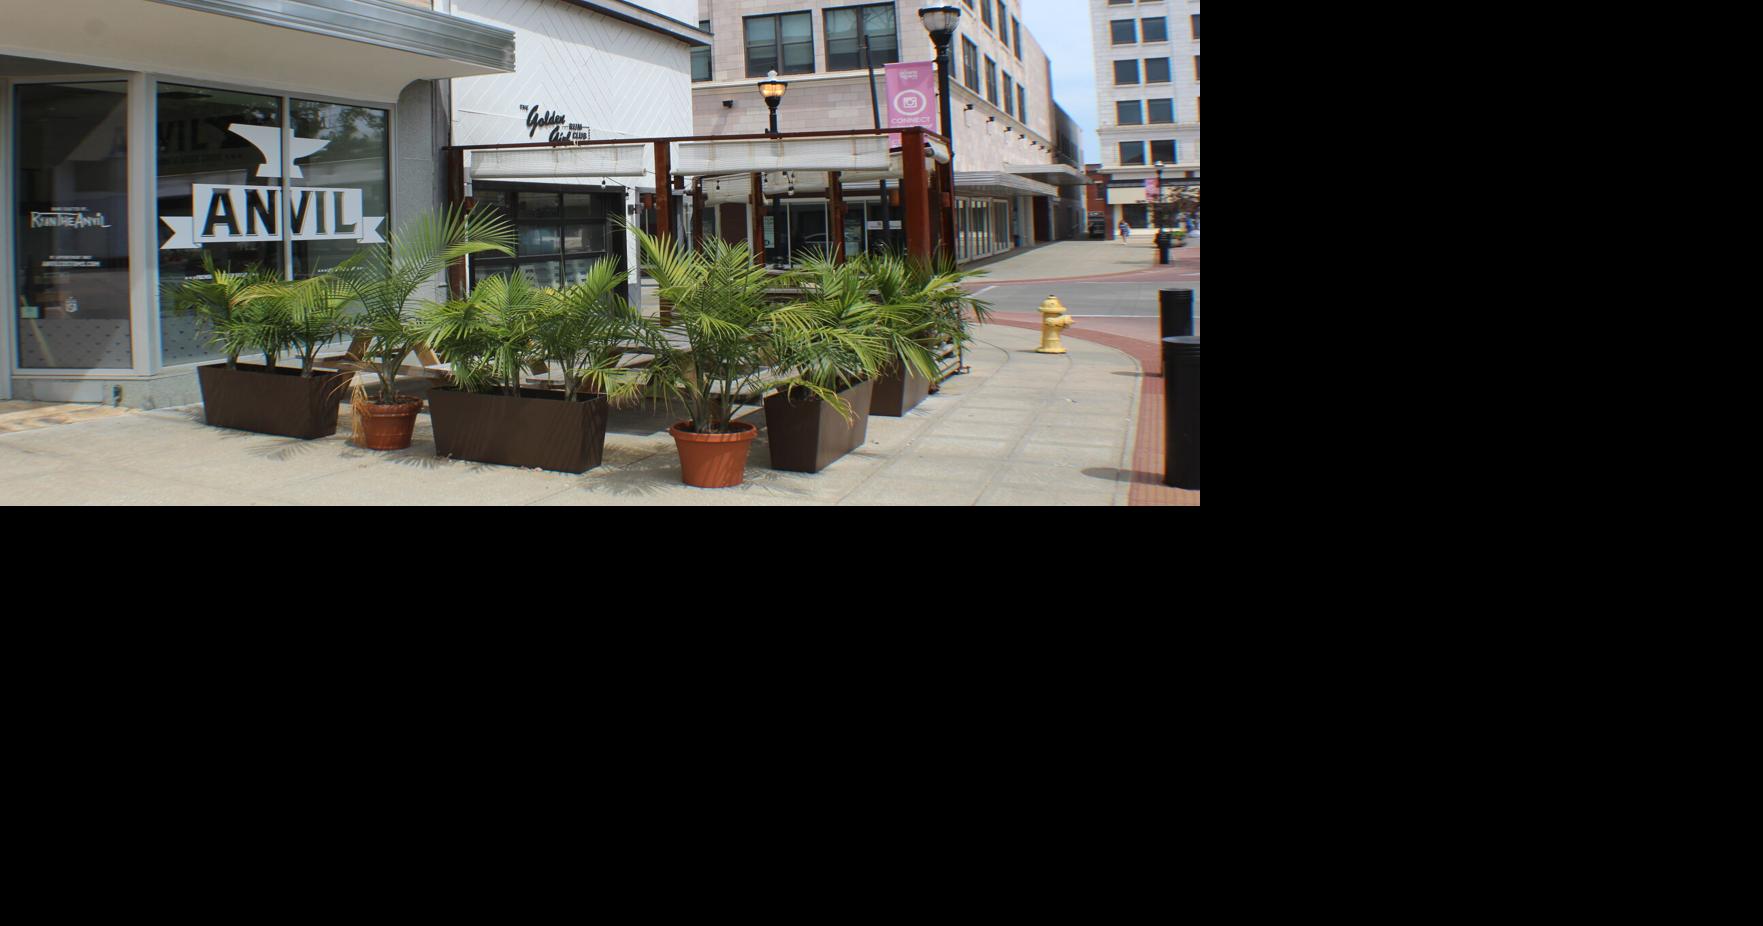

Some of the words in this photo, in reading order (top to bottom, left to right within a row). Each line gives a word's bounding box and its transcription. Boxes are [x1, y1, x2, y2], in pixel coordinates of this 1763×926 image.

[526, 105, 565, 138] Golden
[891, 116, 930, 124] CONNECT
[201, 188, 357, 237] ANVIL
